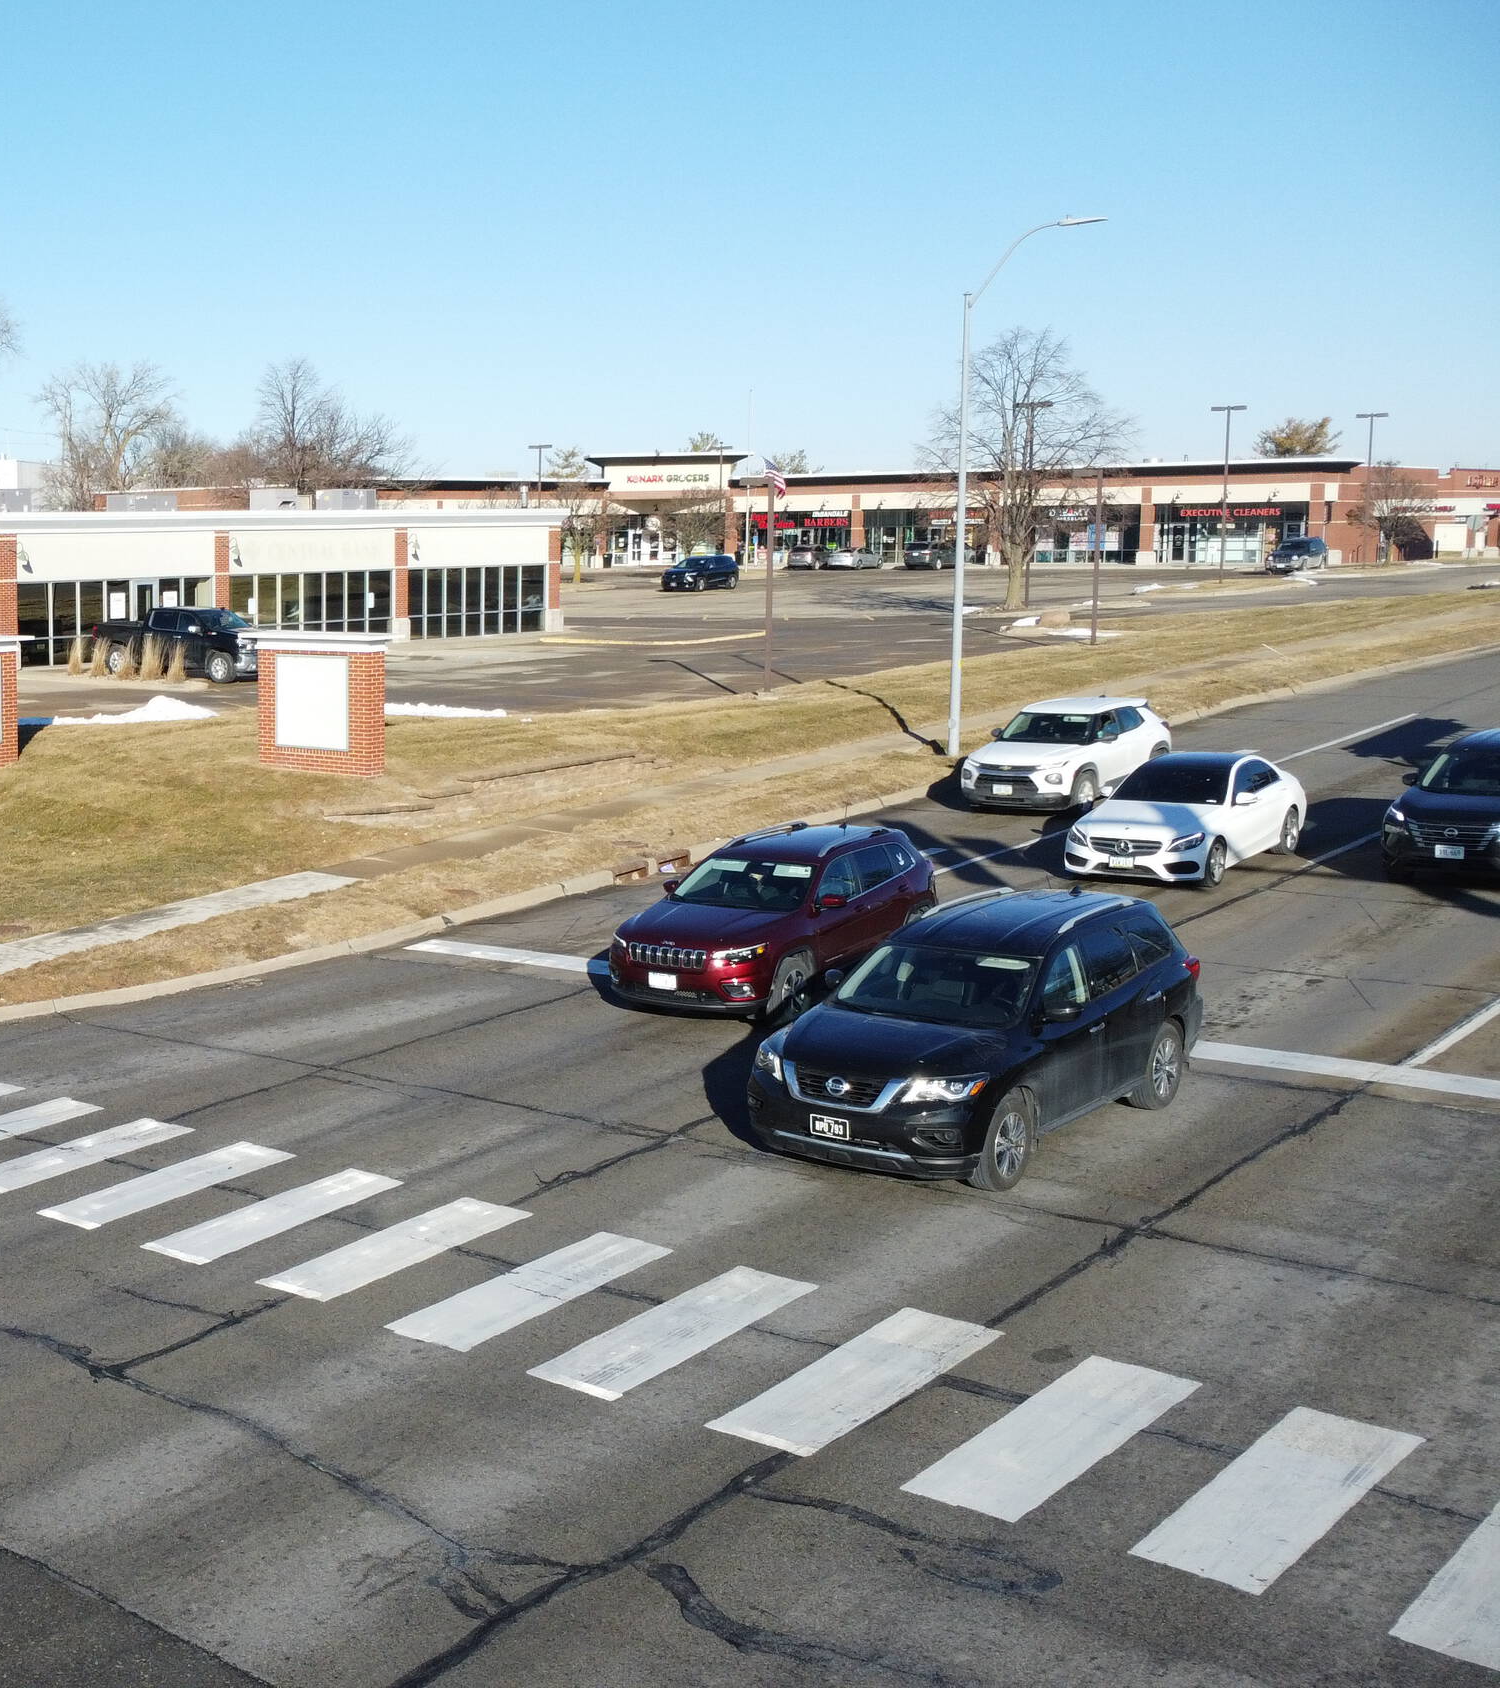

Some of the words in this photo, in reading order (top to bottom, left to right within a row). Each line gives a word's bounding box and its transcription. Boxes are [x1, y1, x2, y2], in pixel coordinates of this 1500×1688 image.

[666, 474, 710, 483] GROCERS
[1180, 508, 1230, 517] EXECUTIVE
[1234, 507, 1281, 517] CLEANERS
[804, 517, 849, 527] BARBERS
